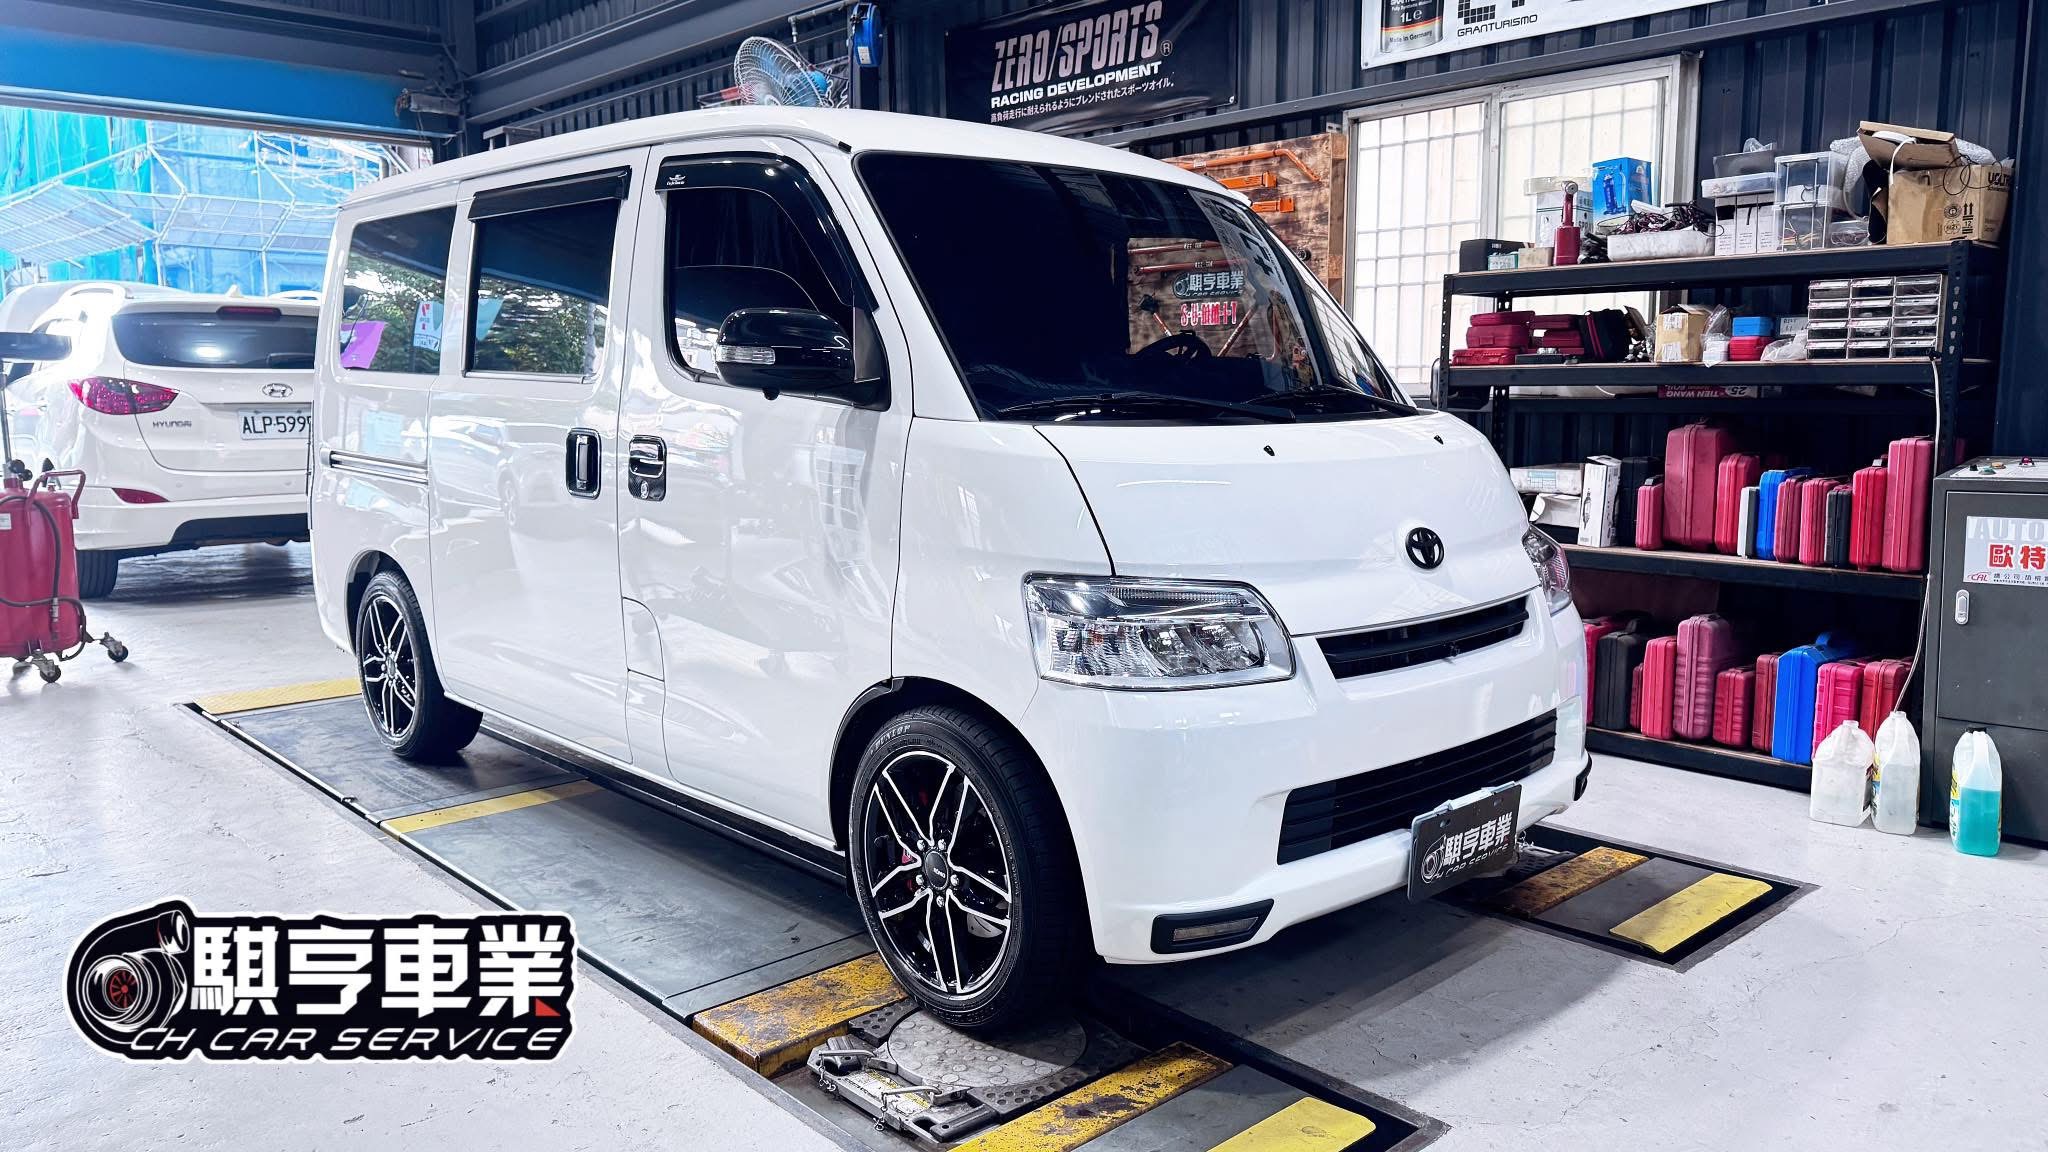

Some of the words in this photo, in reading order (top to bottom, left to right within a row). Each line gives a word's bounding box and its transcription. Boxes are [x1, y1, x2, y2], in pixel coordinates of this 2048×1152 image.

[1457, 14, 1538, 37] GRANTURISMO
[991, 87, 1044, 109] RACING
[1046, 61, 1162, 97] DEVELOPMENT
[1730, 385, 1749, 396] 25
[152, 420, 193, 431] HYUNDAI
[1989, 544, 2046, 570] 歐特
